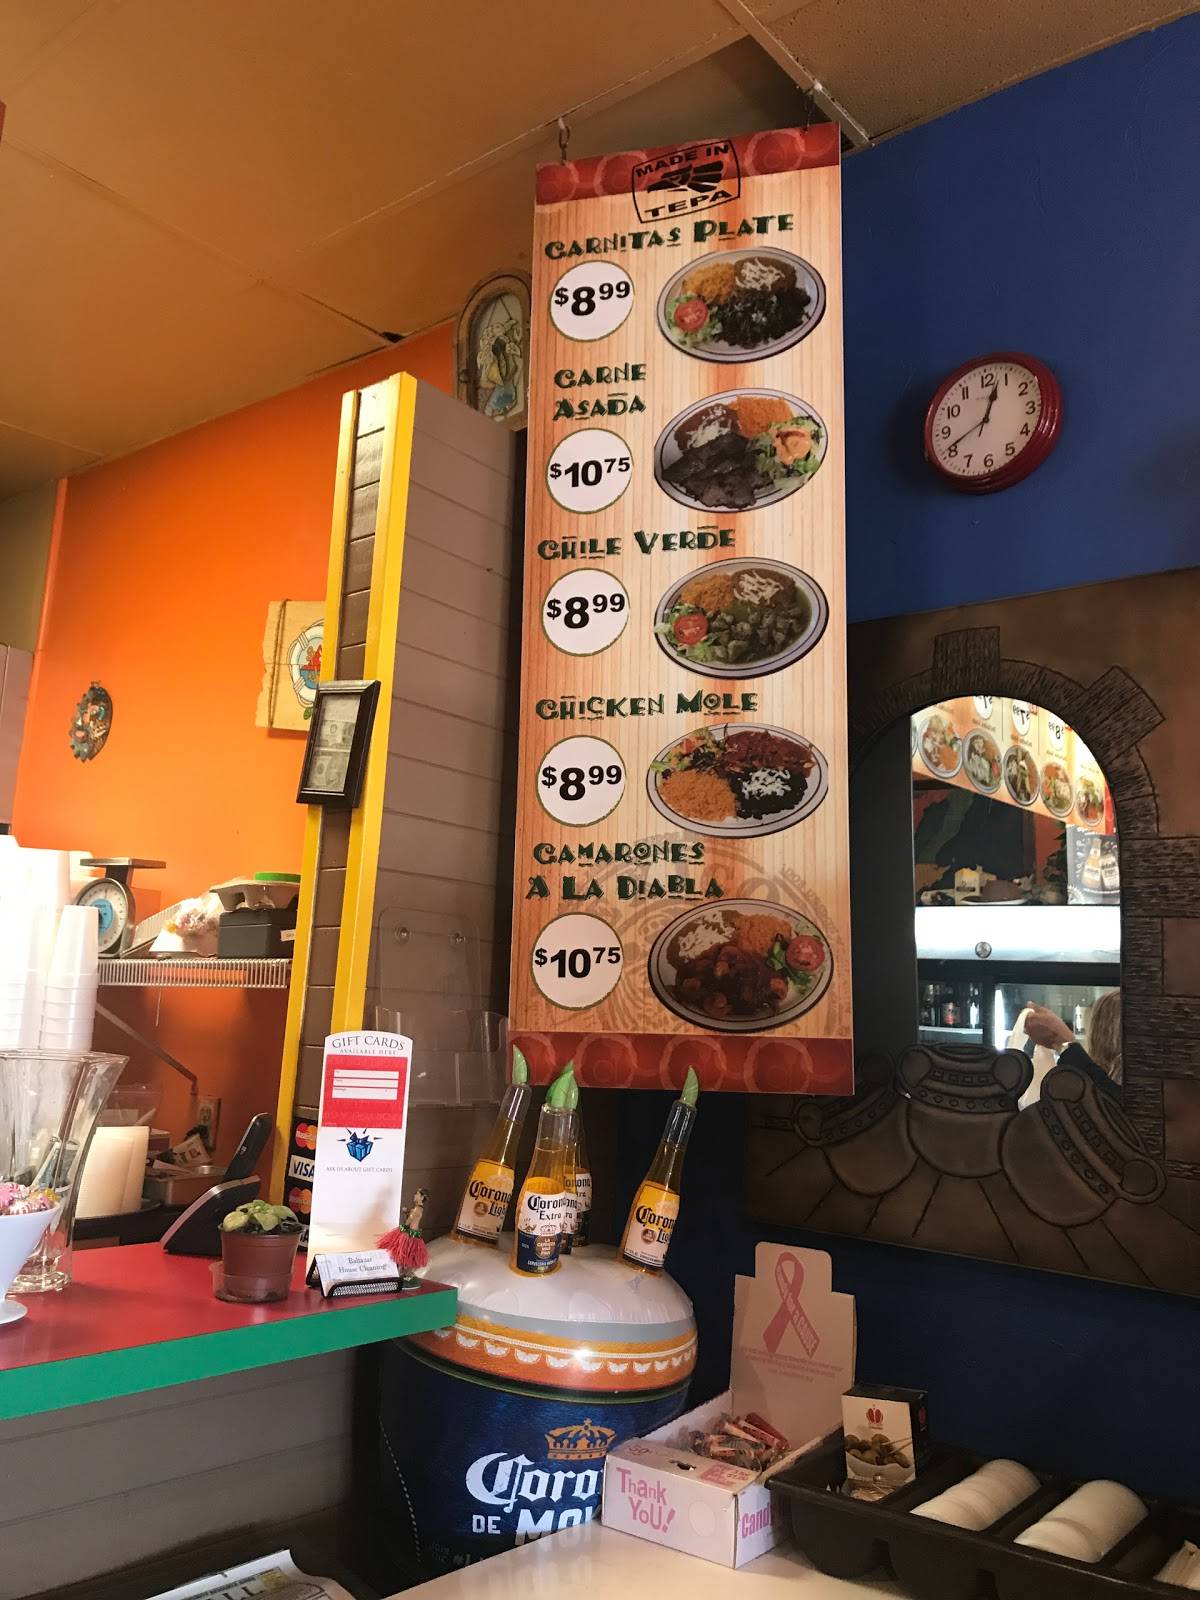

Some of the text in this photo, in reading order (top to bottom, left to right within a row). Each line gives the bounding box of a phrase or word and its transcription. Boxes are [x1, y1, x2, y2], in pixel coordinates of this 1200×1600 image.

[636, 145, 729, 177] MADE IN
[644, 190, 732, 217] TEPA
[545, 214, 794, 260] CARNITAS PLATE
[554, 363, 647, 388] CARNE
[980, 373, 994, 388] 12
[1004, 373, 1009, 386] 1
[961, 386, 970, 400] 11
[1018, 382, 1028, 396] 2
[552, 393, 647, 421] ASADA
[947, 404, 961, 419] 10
[1025, 400, 1036, 415] 3
[941, 426, 951, 439] 9
[1020, 422, 1031, 437] 4
[948, 443, 958, 457] 8
[1005, 442, 1016, 456] 5
[964, 454, 973, 468] 7
[983, 454, 994, 467] 6
[537, 526, 735, 560] CHILE VERDE
[535, 689, 758, 720] CHICKEN MOLE
[533, 842, 705, 867] CAMARONES
[526, 875, 724, 900] A LA DIABLA
[332, 1036, 404, 1051] GIFT CARDS
[293, 1161, 315, 1178] VISA
[539, 1211, 562, 1221] Extra
[466, 1453, 602, 1512] Coro
[616, 1467, 667, 1506] Thank
[472, 1514, 501, 1534] DE
